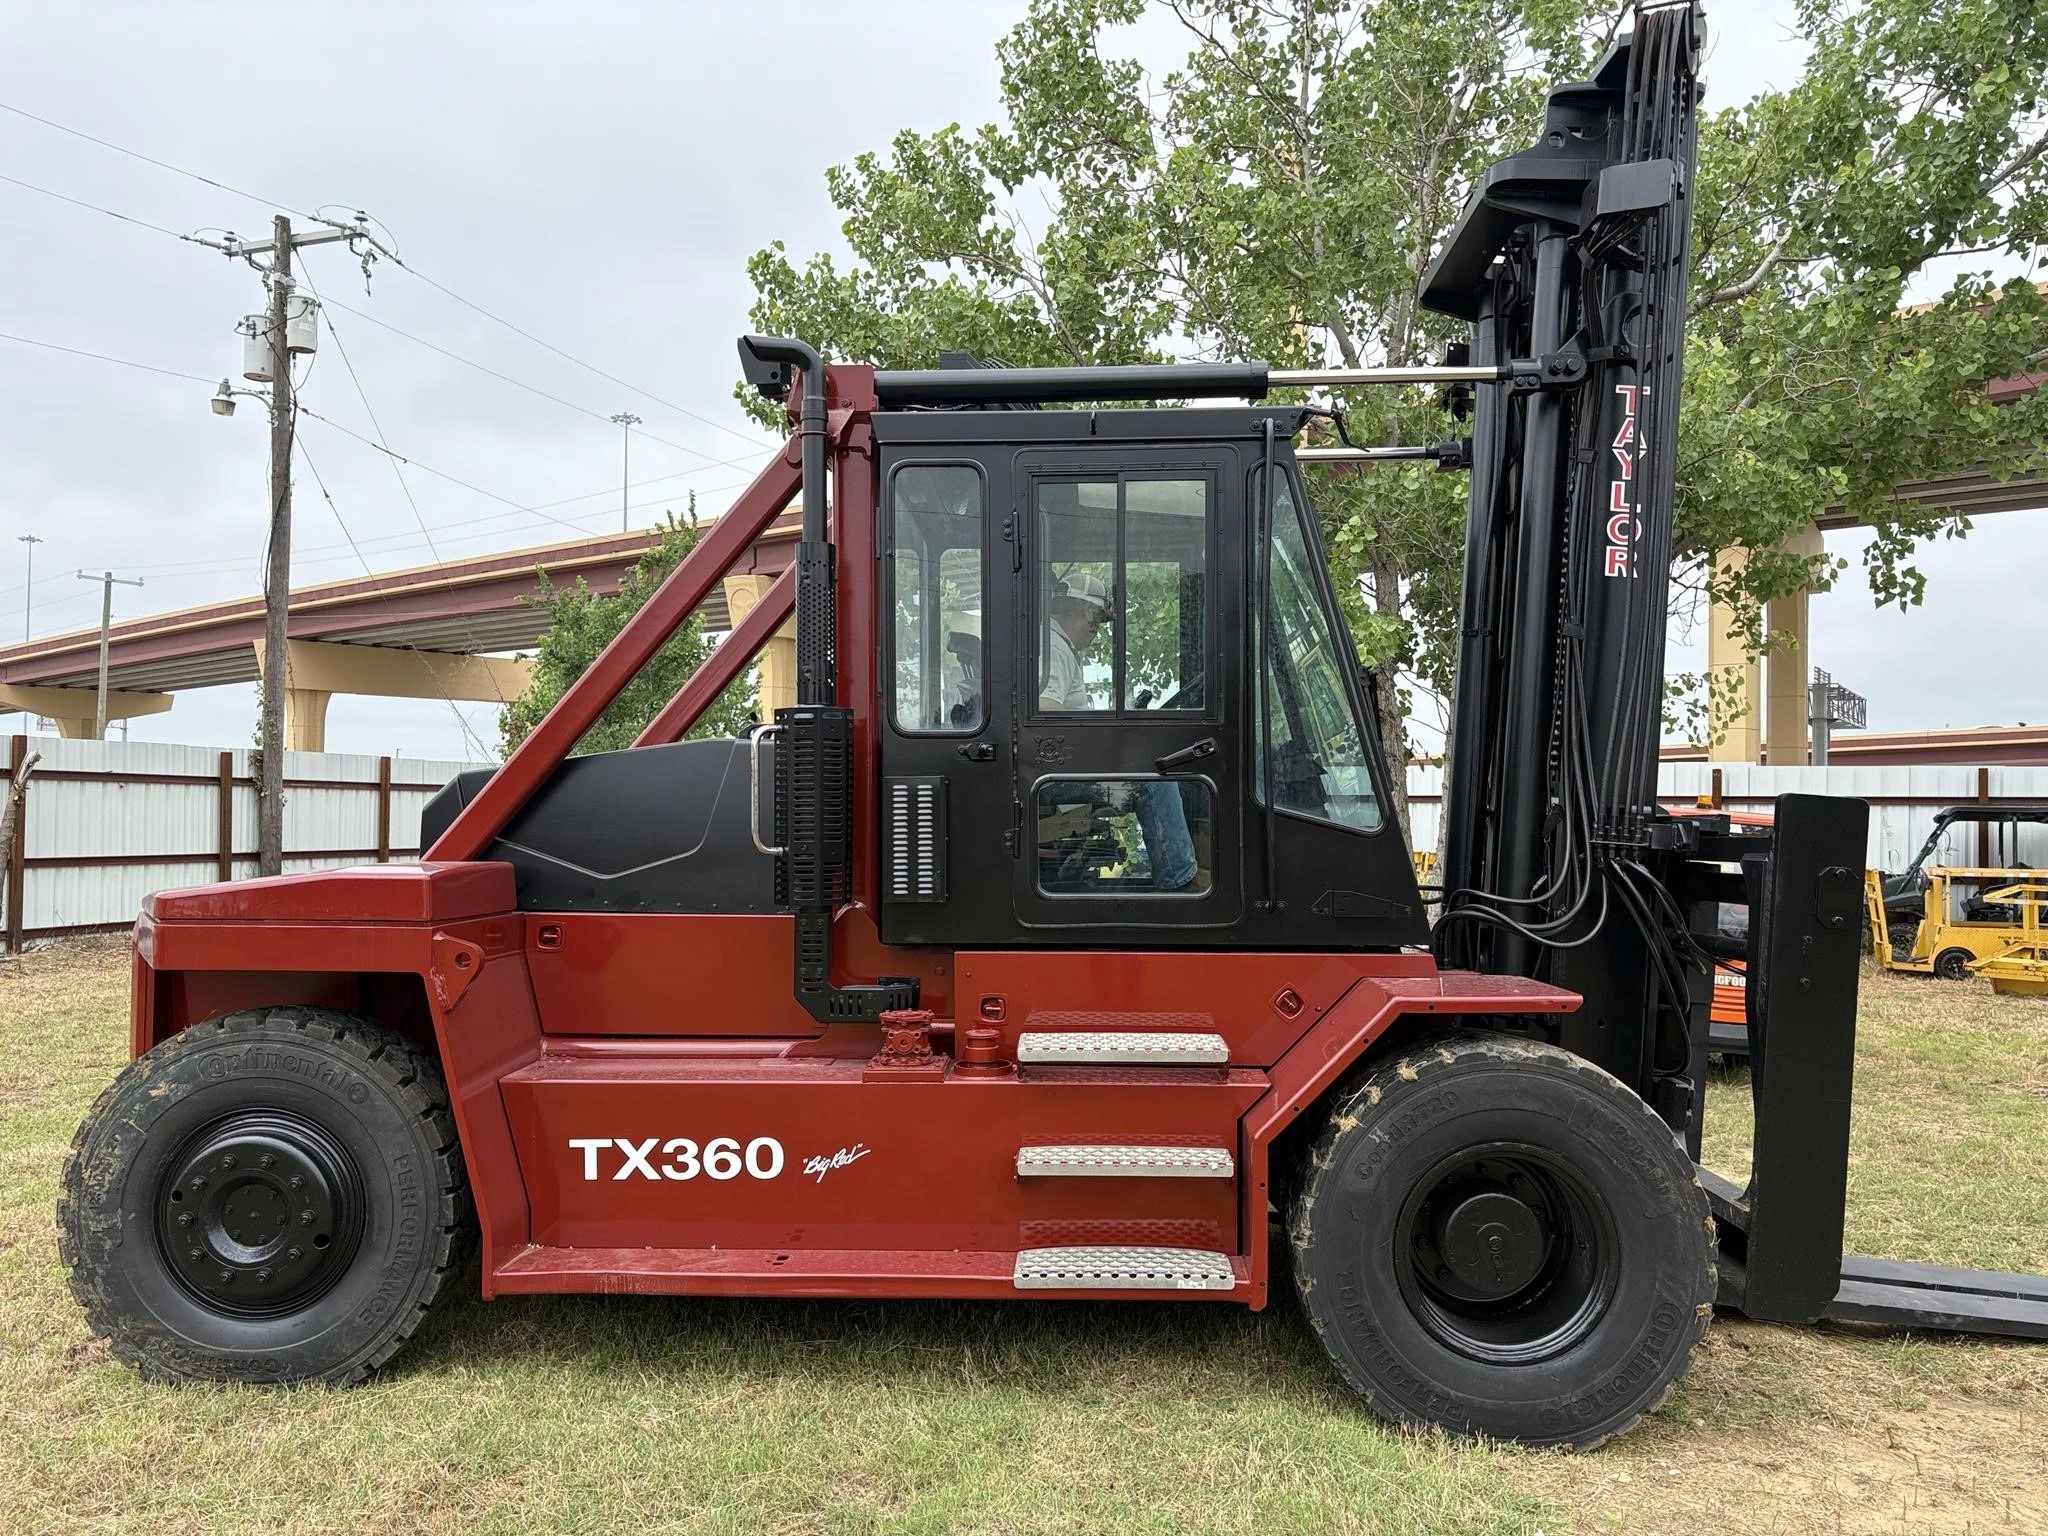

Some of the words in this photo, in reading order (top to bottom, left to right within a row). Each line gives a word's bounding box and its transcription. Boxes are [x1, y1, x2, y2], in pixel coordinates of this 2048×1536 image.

[1604, 385, 1651, 578] TAYLOR
[569, 1136, 785, 1181] TX360
[358, 1153, 418, 1326] PERFORMANCE
[1336, 1272, 1465, 1422] PERFORMANCE
